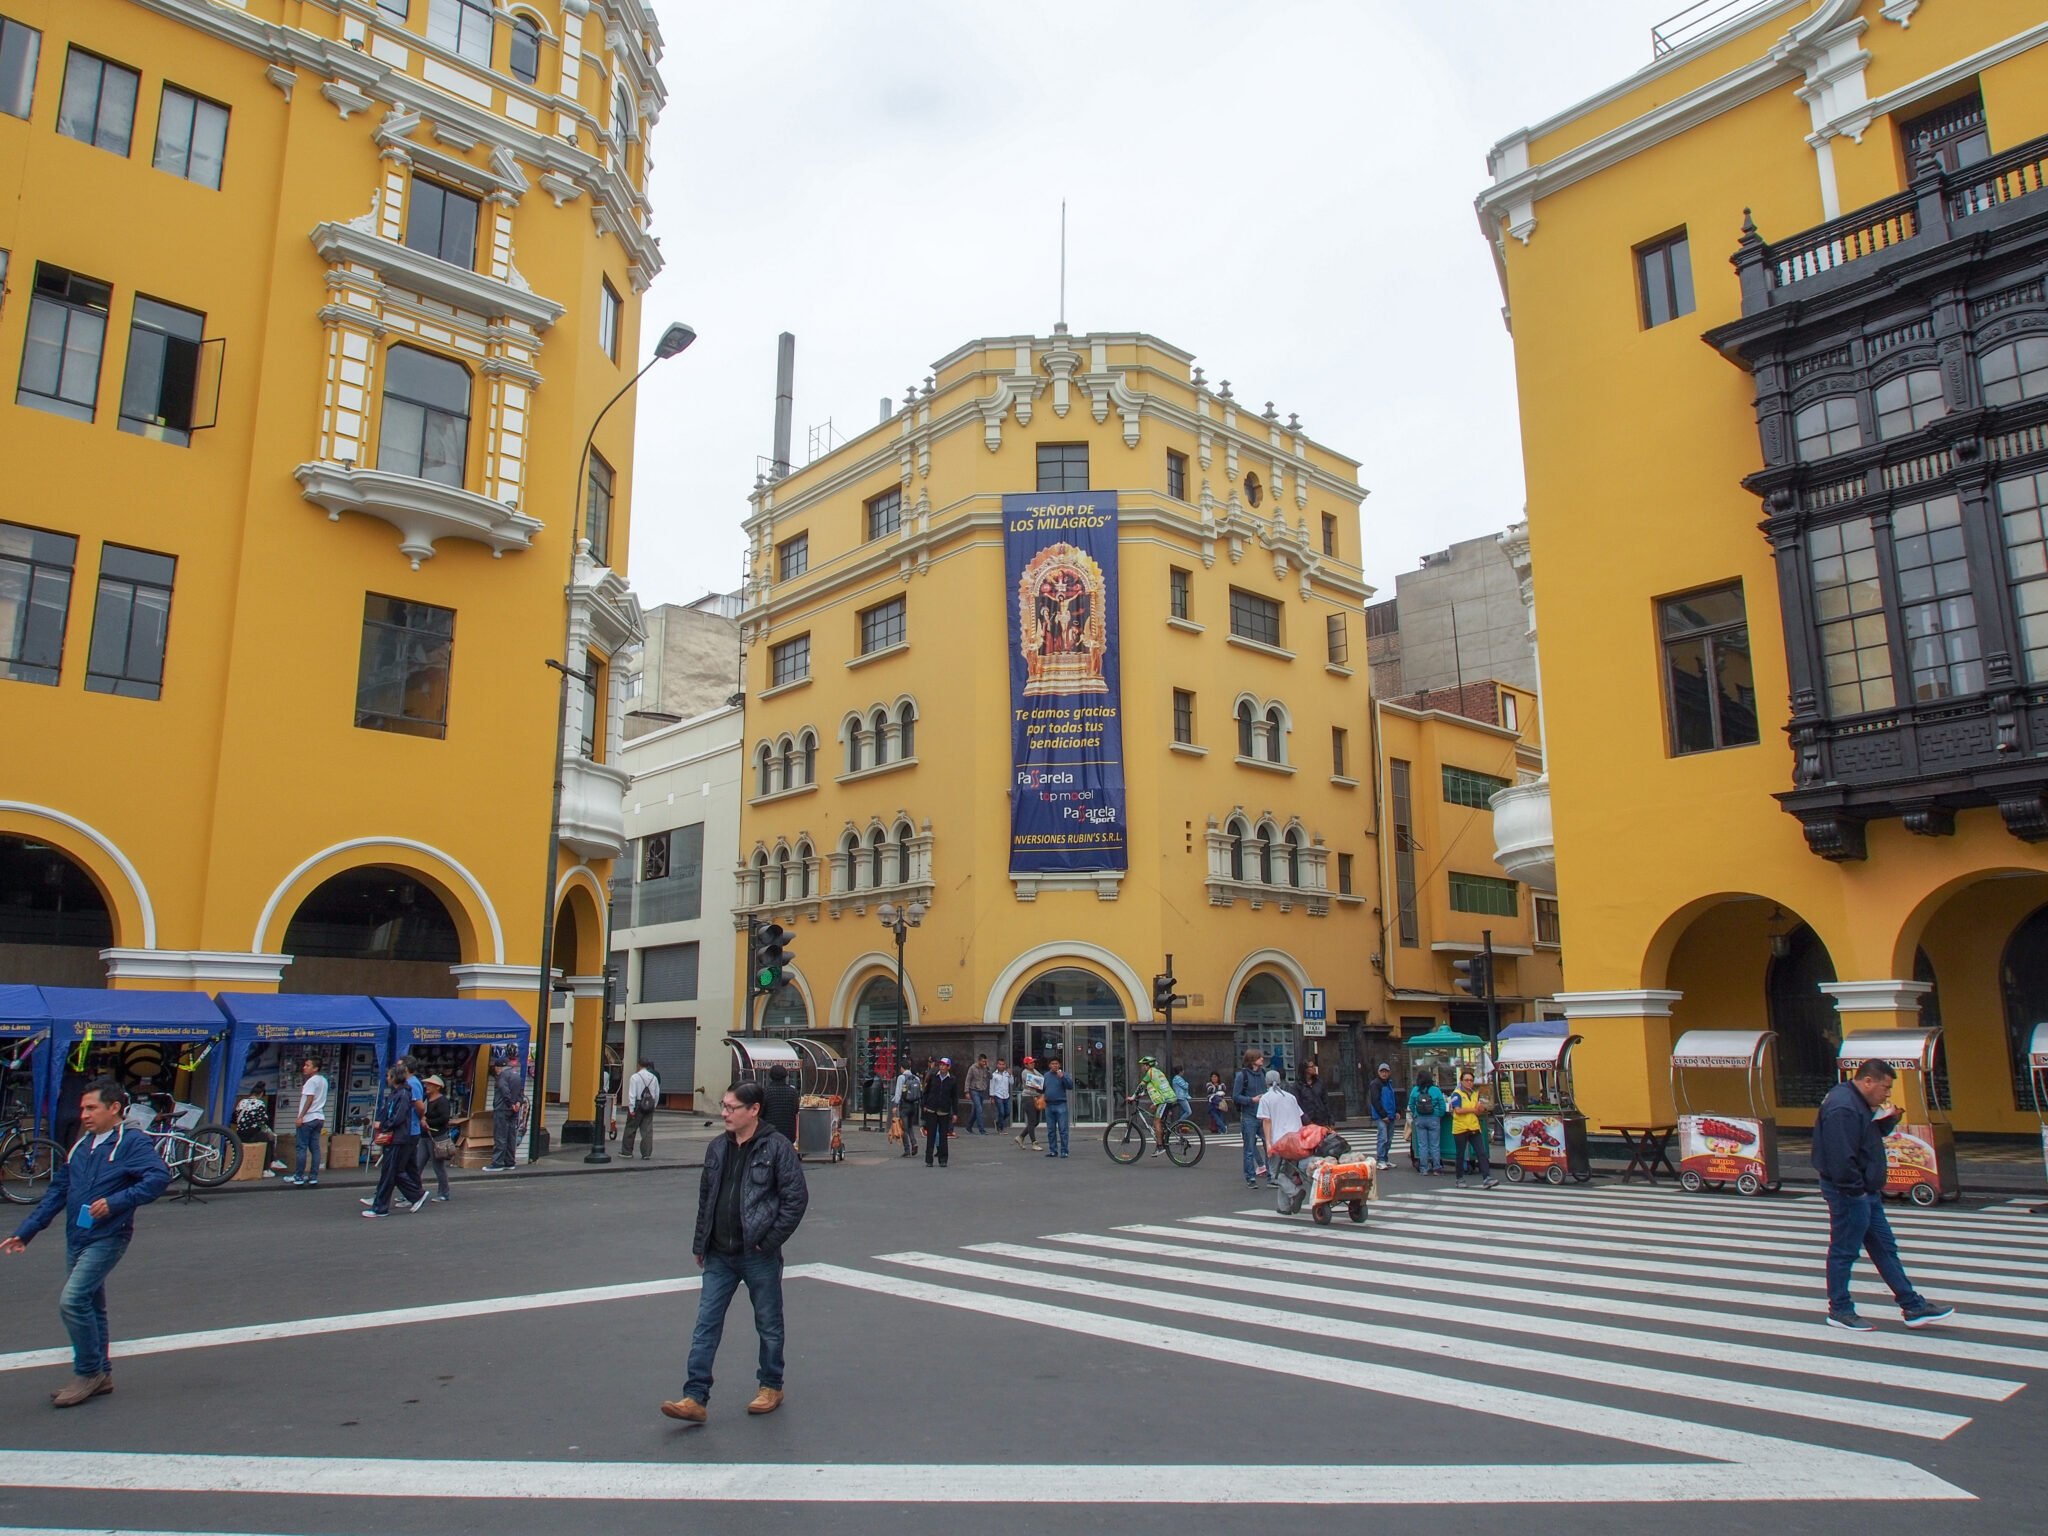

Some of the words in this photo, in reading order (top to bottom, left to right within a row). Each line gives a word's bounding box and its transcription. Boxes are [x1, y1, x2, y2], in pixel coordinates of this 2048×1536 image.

[1077, 504, 1095, 515] DE
[1010, 520, 1034, 532] LOS
[1015, 709, 1029, 721] Te
[1031, 707, 1070, 719] damos
[1073, 705, 1116, 720] gracias
[1027, 724, 1046, 736] por
[1049, 722, 1082, 733] todas
[1085, 721, 1104, 732] tus
[1030, 736, 1100, 749] bendiciones
[1040, 791, 1057, 802] top
[1059, 790, 1094, 801] model
[1068, 832, 1100, 844] RUBIN'S
[1102, 832, 1123, 843] S.R.L.
[1310, 993, 1318, 1008] T
[132, 1028, 180, 1036] Municipalidad
[457, 1032, 495, 1040] Municipalidad
[1500, 1062, 1553, 1070] ANTICUCHOS
